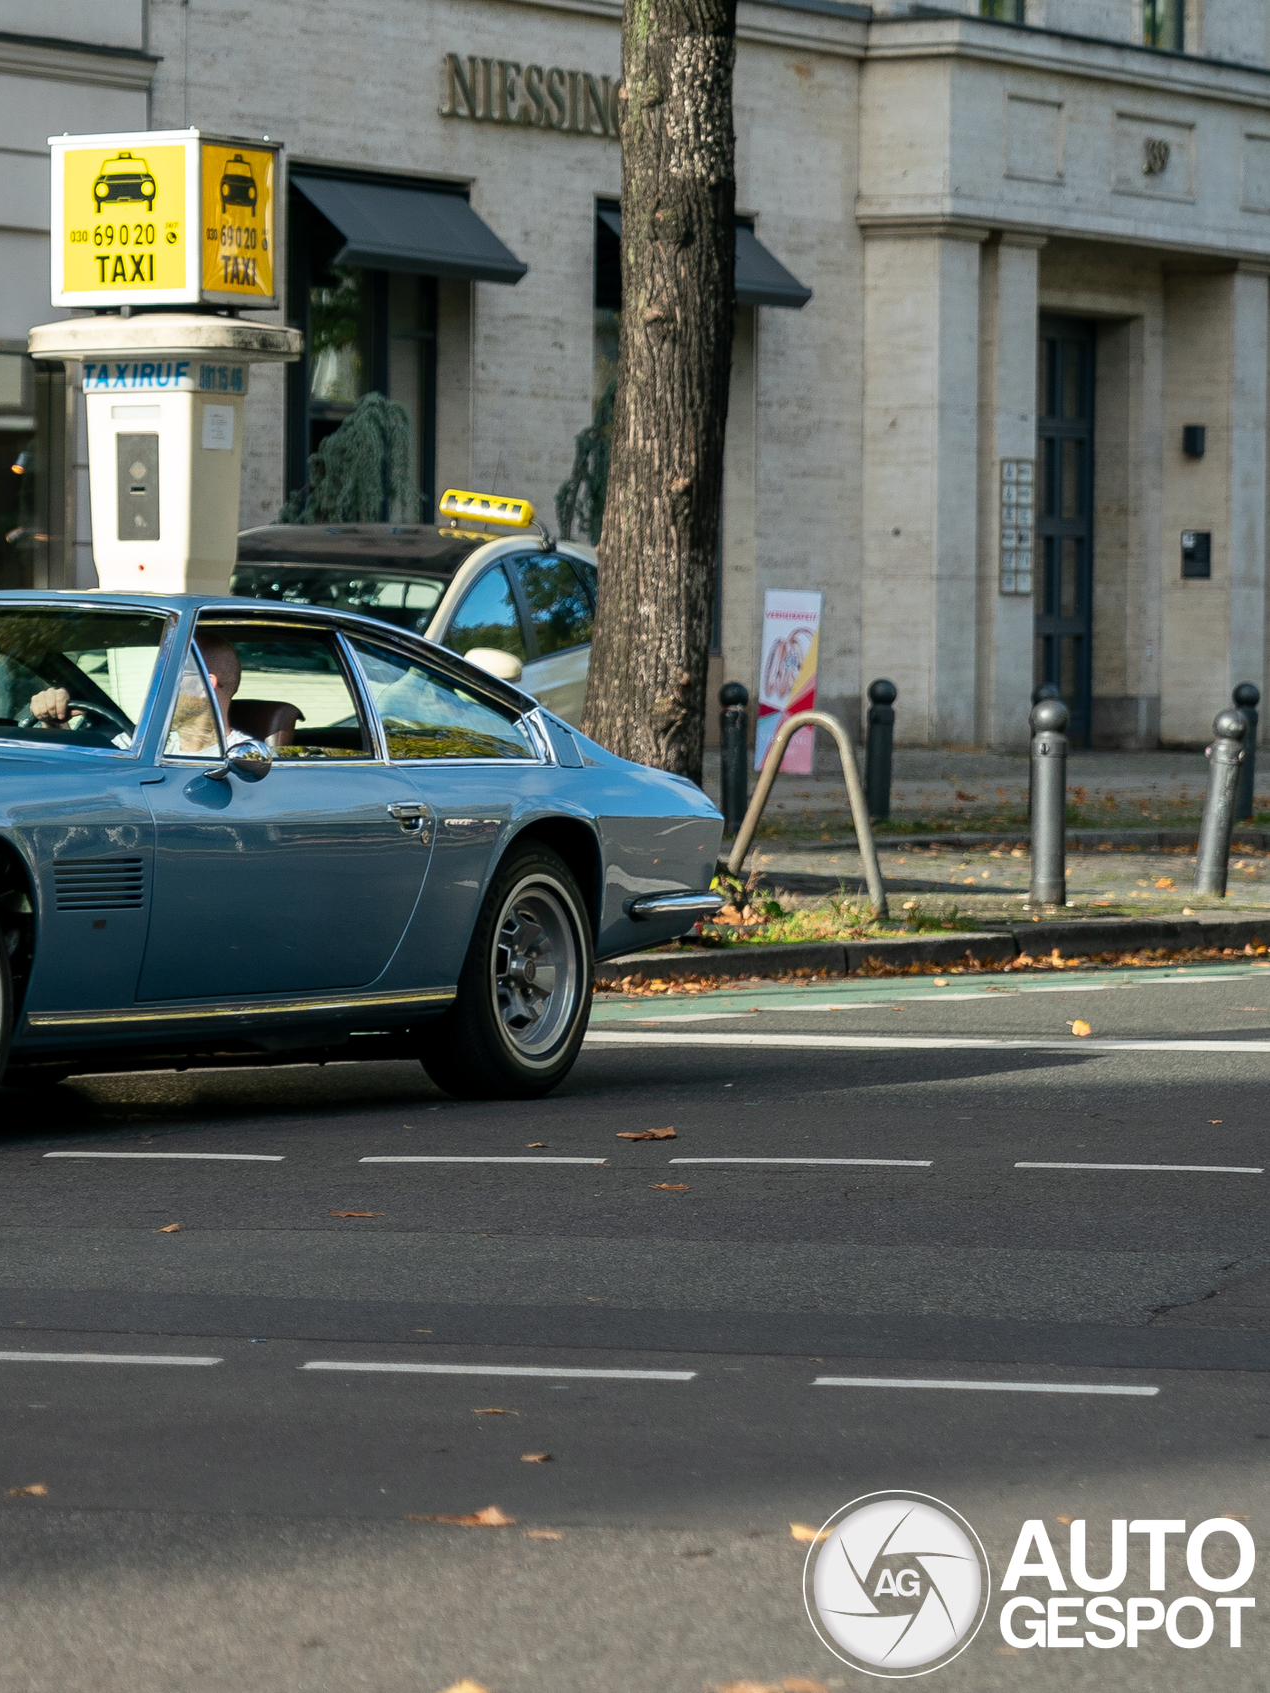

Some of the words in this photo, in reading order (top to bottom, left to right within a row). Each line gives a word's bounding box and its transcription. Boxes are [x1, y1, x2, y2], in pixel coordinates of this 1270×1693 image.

[95, 254, 154, 283] TAXI
[221, 255, 256, 286] TAXI
[83, 361, 190, 388] TAXIRUF
